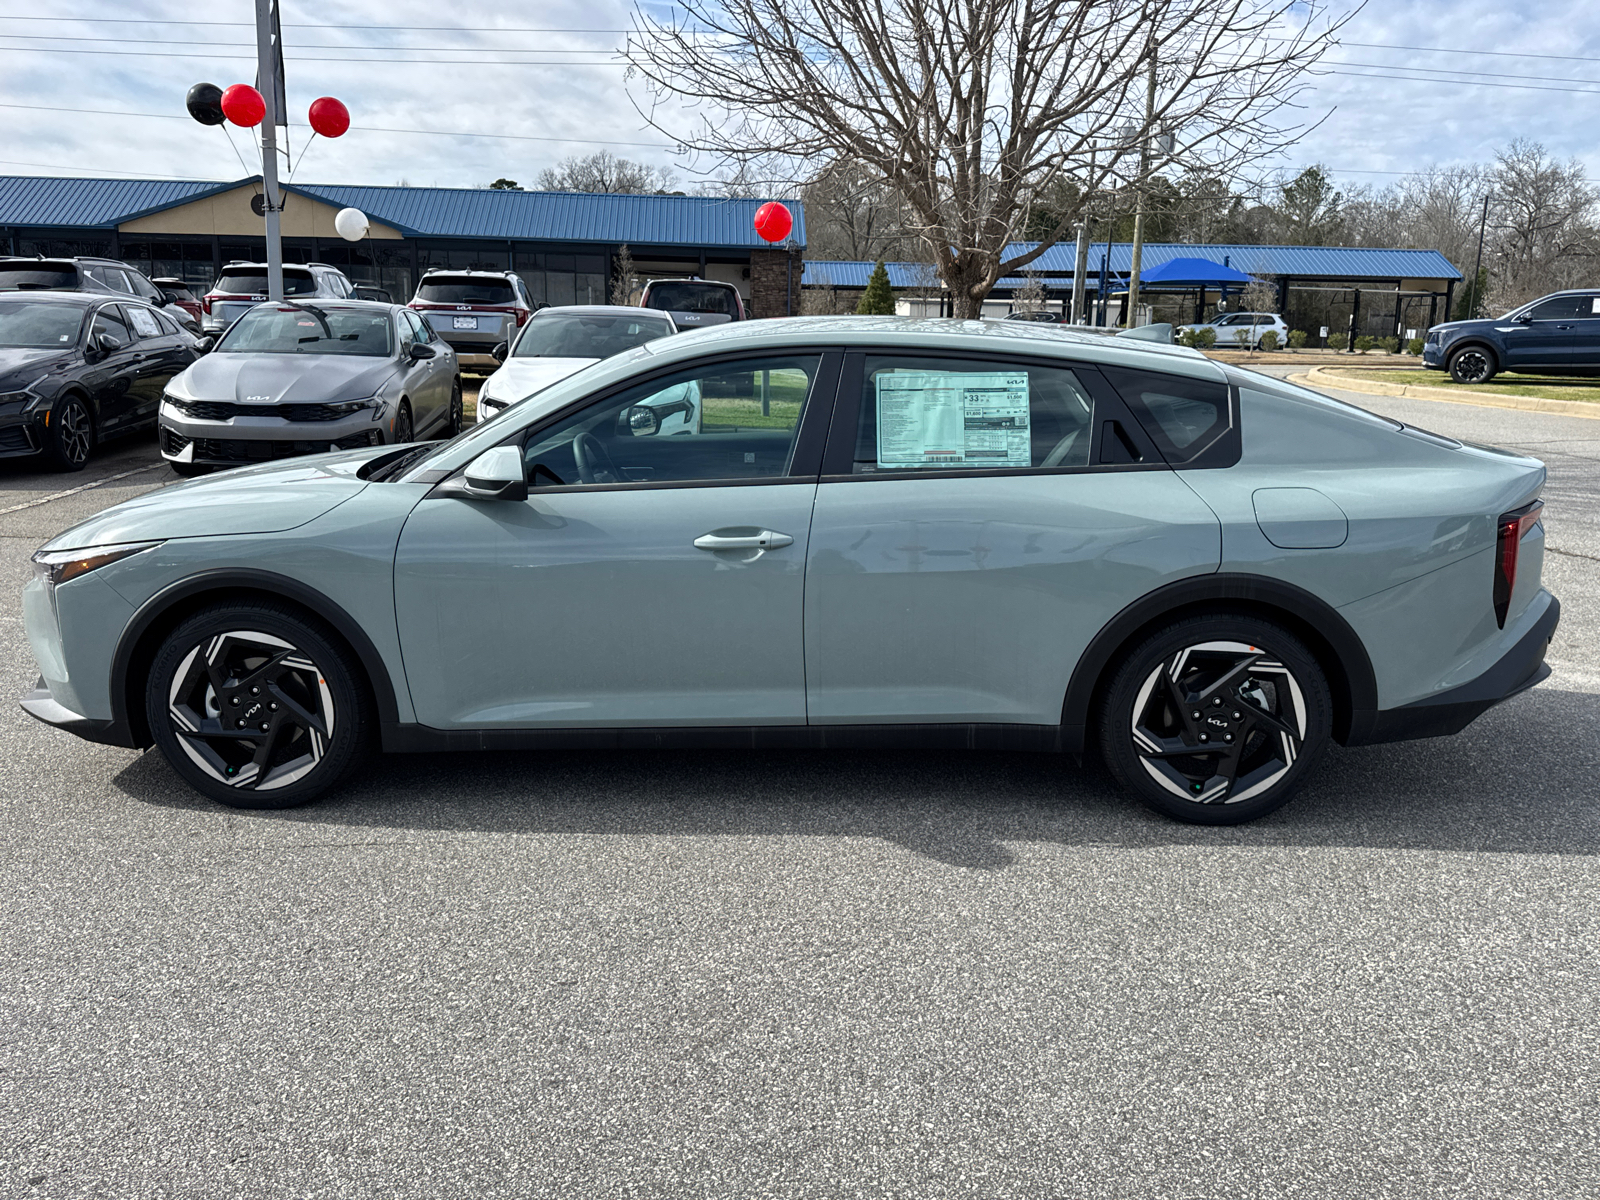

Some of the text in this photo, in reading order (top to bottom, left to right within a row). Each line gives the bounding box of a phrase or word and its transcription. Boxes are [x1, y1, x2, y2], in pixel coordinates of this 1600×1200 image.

[968, 394, 979, 402] 33
[153, 644, 178, 690] KUMHO
[1306, 670, 1325, 718] SOLUS
[245, 703, 261, 718] KIA
[1207, 717, 1228, 728] KIA
[328, 726, 350, 770] SOLUS
